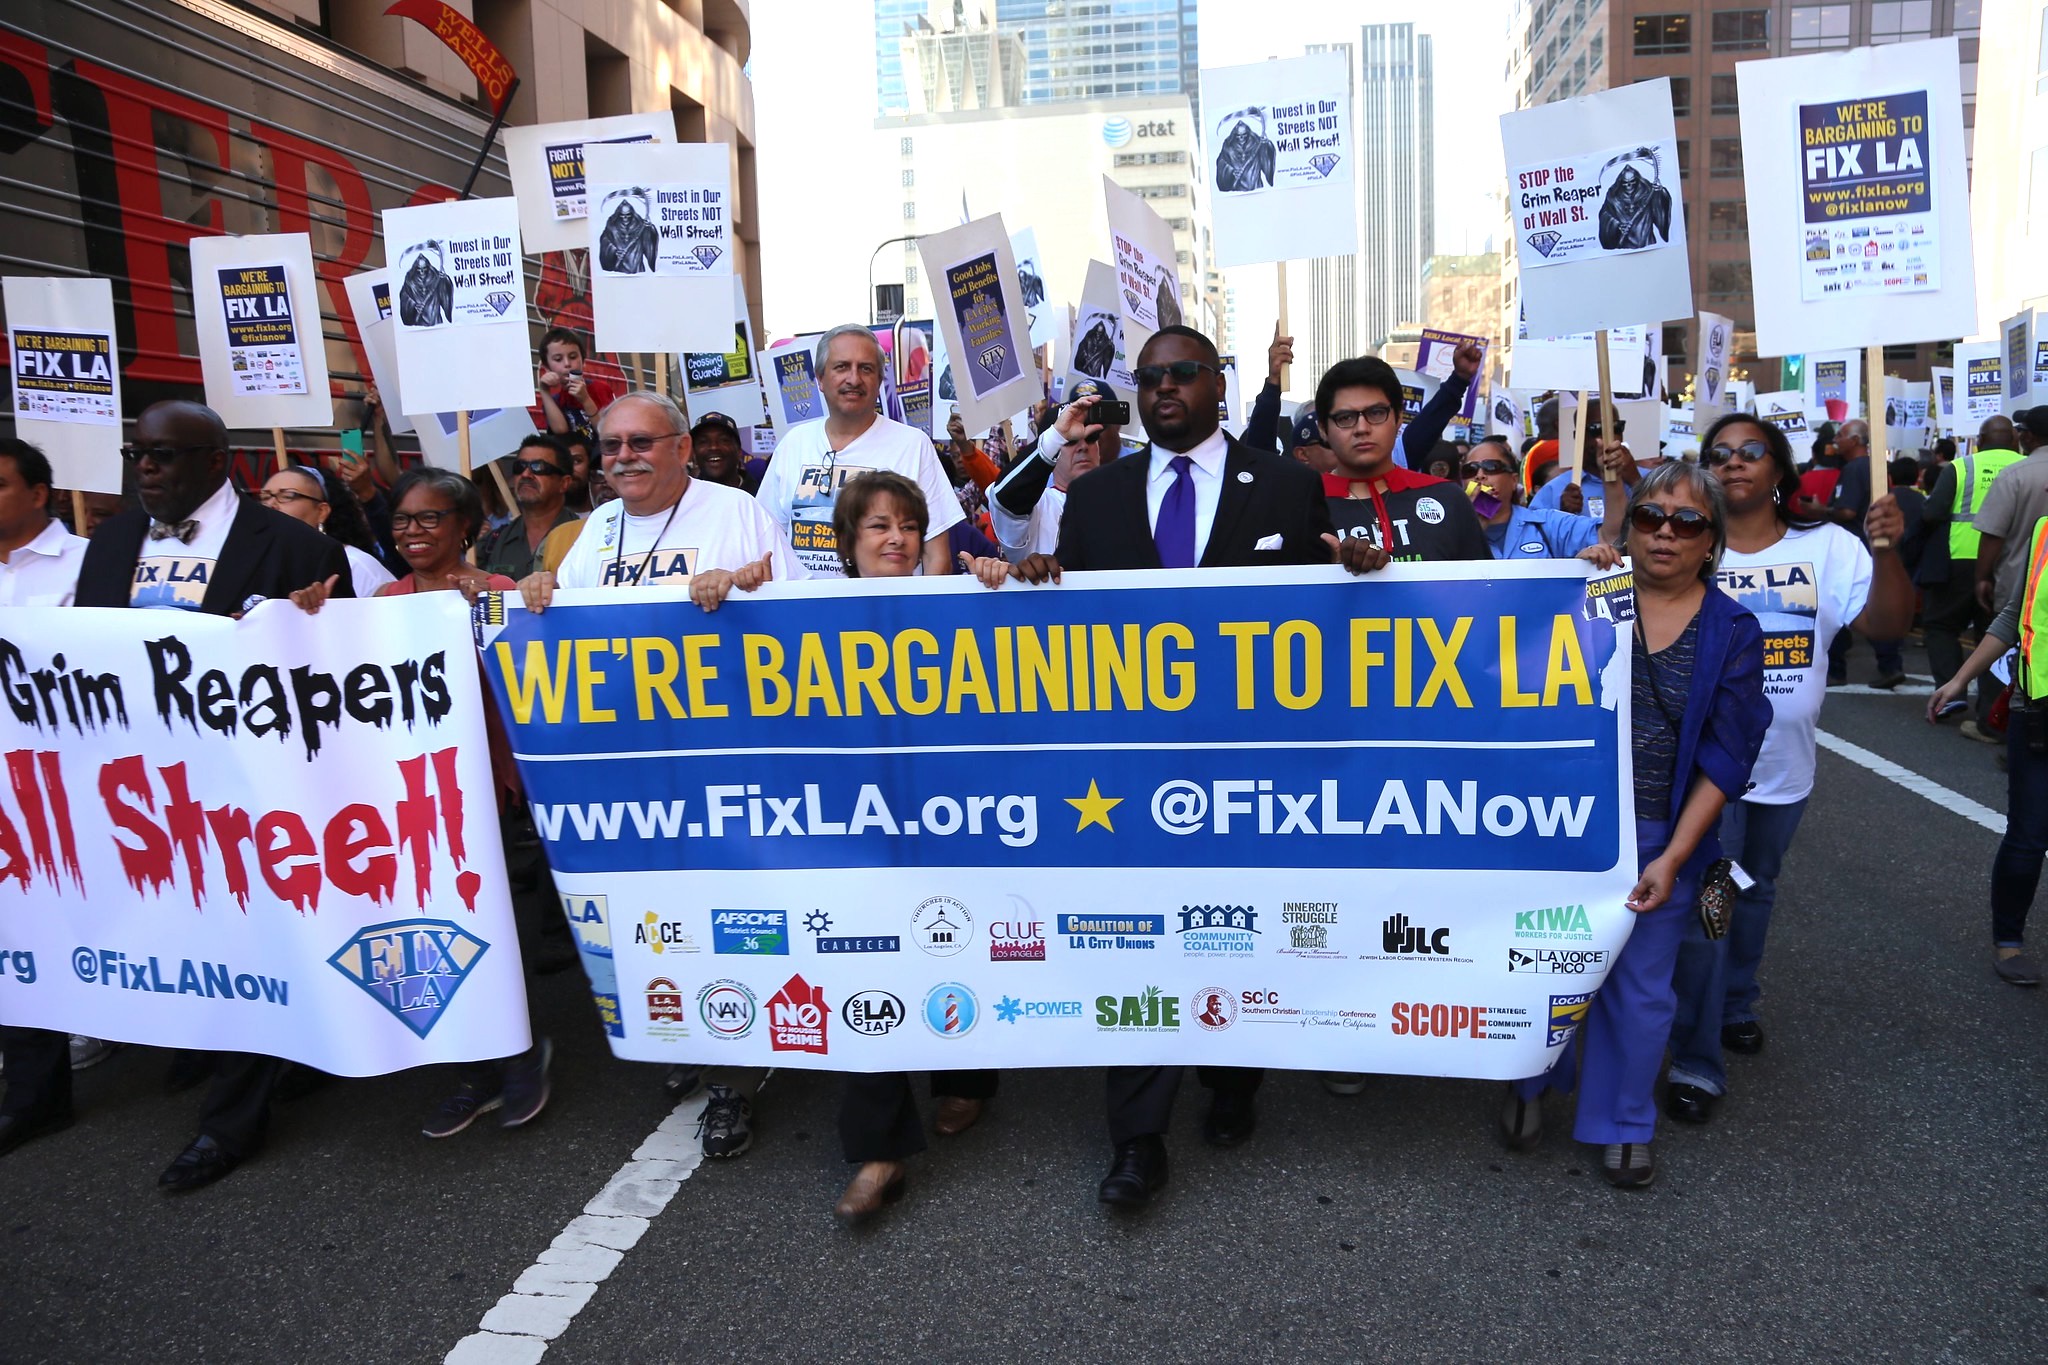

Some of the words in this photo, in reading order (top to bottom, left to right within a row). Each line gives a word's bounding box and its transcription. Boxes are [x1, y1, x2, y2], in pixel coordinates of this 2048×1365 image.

[441, 5, 513, 85] WELLS
[435, 17, 502, 99] FARGO
[1272, 104, 1303, 119] Invest
[1306, 102, 1315, 115] in
[1318, 100, 1337, 114] Our
[1837, 101, 1887, 123] WE'RE
[1137, 119, 1175, 138] at&t
[1277, 120, 1315, 135] Streets
[1318, 116, 1338, 131] NOT
[1805, 119, 1896, 146] BARGAINING
[1901, 115, 1923, 135] TO
[1277, 137, 1300, 153] Wall
[1303, 133, 1340, 150] Street!
[549, 148, 575, 163] FIGHT
[1806, 144, 1864, 180] FIX
[1876, 138, 1924, 173] LA
[551, 162, 575, 179] NOT
[1519, 169, 1550, 190] STOP
[1554, 166, 1574, 183] the
[657, 190, 688, 204] Invest
[690, 189, 700, 203] in
[703, 189, 721, 203] Our
[1521, 192, 1551, 210] Grim
[1553, 185, 1602, 204] Reaper
[1809, 182, 1925, 204] www.fixla.org
[661, 207, 699, 221] Streets
[702, 207, 722, 221] NOT
[1825, 198, 1909, 217] @fixlanow
[1524, 213, 1537, 230] of
[1539, 208, 1567, 228] Wall
[1571, 205, 1589, 222] St.
[660, 225, 683, 240] Wall
[687, 225, 723, 240] Street!
[449, 238, 478, 254] Invest
[481, 237, 491, 251] in
[493, 236, 511, 249] Our
[454, 255, 490, 271] Streets
[493, 253, 513, 268] NOT
[240, 270, 269, 283] WE'RE
[454, 273, 477, 289] Wall
[480, 270, 515, 287] Street!
[952, 266, 974, 284] Good
[974, 261, 992, 276] Jobs
[223, 282, 275, 297] BARGAINING
[275, 281, 286, 293] TO
[952, 284, 968, 298] and
[968, 273, 998, 292] Benefits
[225, 297, 260, 319] FIX
[264, 295, 290, 317] LA
[973, 293, 985, 304] for
[966, 309, 978, 321] LA
[231, 323, 292, 334] www.fixla.org
[968, 315, 1001, 334] Working
[15, 334, 43, 349] WE'RE
[44, 336, 96, 352] BARGAINING
[98, 339, 109, 353] TO
[241, 333, 286, 343] @fixlanow
[17, 350, 66, 378] FIX
[72, 353, 111, 381] LA
[688, 354, 724, 370] Crossing
[784, 362, 804, 375] NOT
[691, 366, 722, 381] Guards
[1969, 372, 1990, 384] FIX
[18, 379, 69, 391] www.fixla.org
[1420, 511, 1442, 521] UNION
[793, 522, 812, 536] Our
[793, 535, 810, 548] Not
[812, 537, 837, 549] Wall
[136, 561, 160, 583] ix
[168, 561, 208, 584] LA
[649, 553, 689, 579] LA
[1765, 566, 1811, 588] LA
[1764, 652, 1784, 666] all
[1789, 650, 1810, 665] St.
[493, 634, 730, 725] WE'RE
[742, 624, 1196, 717] BARGAINING
[1219, 620, 1323, 710] TO
[1350, 616, 1474, 709] FIX
[1500, 614, 1595, 708] LA
[0, 637, 130, 738] Grim
[145, 635, 454, 762] Reapers
[533, 783, 1038, 848] www.FixLA.org
[1151, 779, 1595, 839] @FixLANow
[98, 747, 482, 918] Street!
[566, 898, 604, 925] LA
[912, 898, 943, 923] CHURCHES
[951, 900, 973, 923] ACTION
[1283, 902, 1339, 912] INNERCITY
[715, 912, 784, 926] AFSCME
[1067, 915, 1134, 933] COALITION
[1282, 912, 1338, 924] STRUGGLE
[1515, 904, 1592, 933] KIWA
[635, 921, 683, 945] ACCE
[723, 927, 750, 935] District
[750, 927, 777, 935] Council
[989, 921, 1046, 940] CLUE
[1183, 932, 1254, 942] COMMUNITY
[1515, 931, 1547, 939] WORKERS
[1564, 933, 1593, 941] JUSTICE
[743, 936, 759, 950] 36
[821, 939, 896, 951] CARECEN
[1070, 935, 1086, 950] LA
[1183, 941, 1254, 952] COALITION
[1399, 927, 1450, 955] JLC
[359, 929, 466, 984] FIX
[991, 950, 1009, 959] LOS
[1010, 950, 1044, 959] ANGELES
[1539, 950, 1558, 963] LA
[1559, 951, 1603, 963] VOICE
[72, 946, 289, 1007] @FixLANow
[1552, 962, 1585, 974] PICO
[707, 1001, 747, 1019] NAN
[863, 999, 898, 1021] LA
[1025, 1001, 1083, 1015] POWER
[1552, 996, 1586, 1006] LOCAL
[774, 1002, 822, 1029] NO
[852, 999, 863, 1026] one
[1095, 994, 1180, 1028] SAJE
[1241, 1007, 1271, 1015] Southern
[1272, 1007, 1301, 1016] Christian
[1338, 1010, 1377, 1019] Conference
[1391, 1001, 1487, 1039] SCOPE
[1488, 1007, 1527, 1015] STRATEGIC
[788, 1026, 822, 1035] HOUSING
[864, 1020, 895, 1034] IAF
[1488, 1020, 1532, 1029] COMMUNITY
[776, 1033, 823, 1047] CRIME
